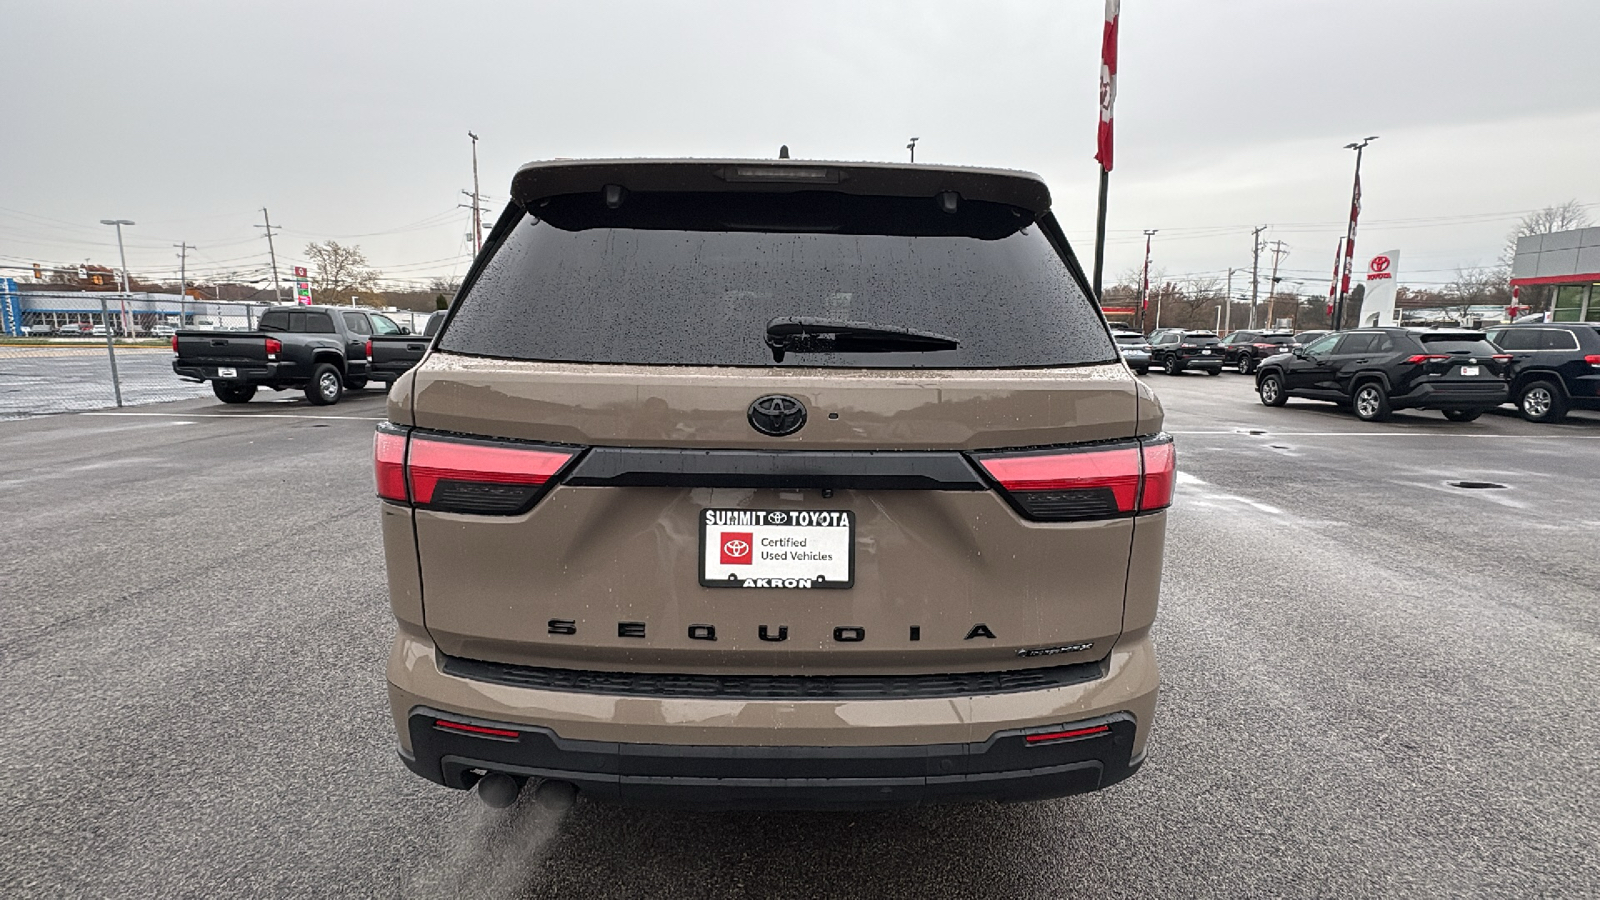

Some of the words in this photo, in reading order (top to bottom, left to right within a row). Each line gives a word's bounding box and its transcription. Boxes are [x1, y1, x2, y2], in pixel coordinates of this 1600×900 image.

[705, 509, 767, 526] SUMMIT
[789, 511, 850, 527] TOYOTA
[760, 537, 807, 548] Certified
[760, 551, 788, 561] Used
[789, 551, 833, 561] Vehicles
[742, 578, 812, 589] AKRON
[547, 617, 998, 642] SEQUOIA
